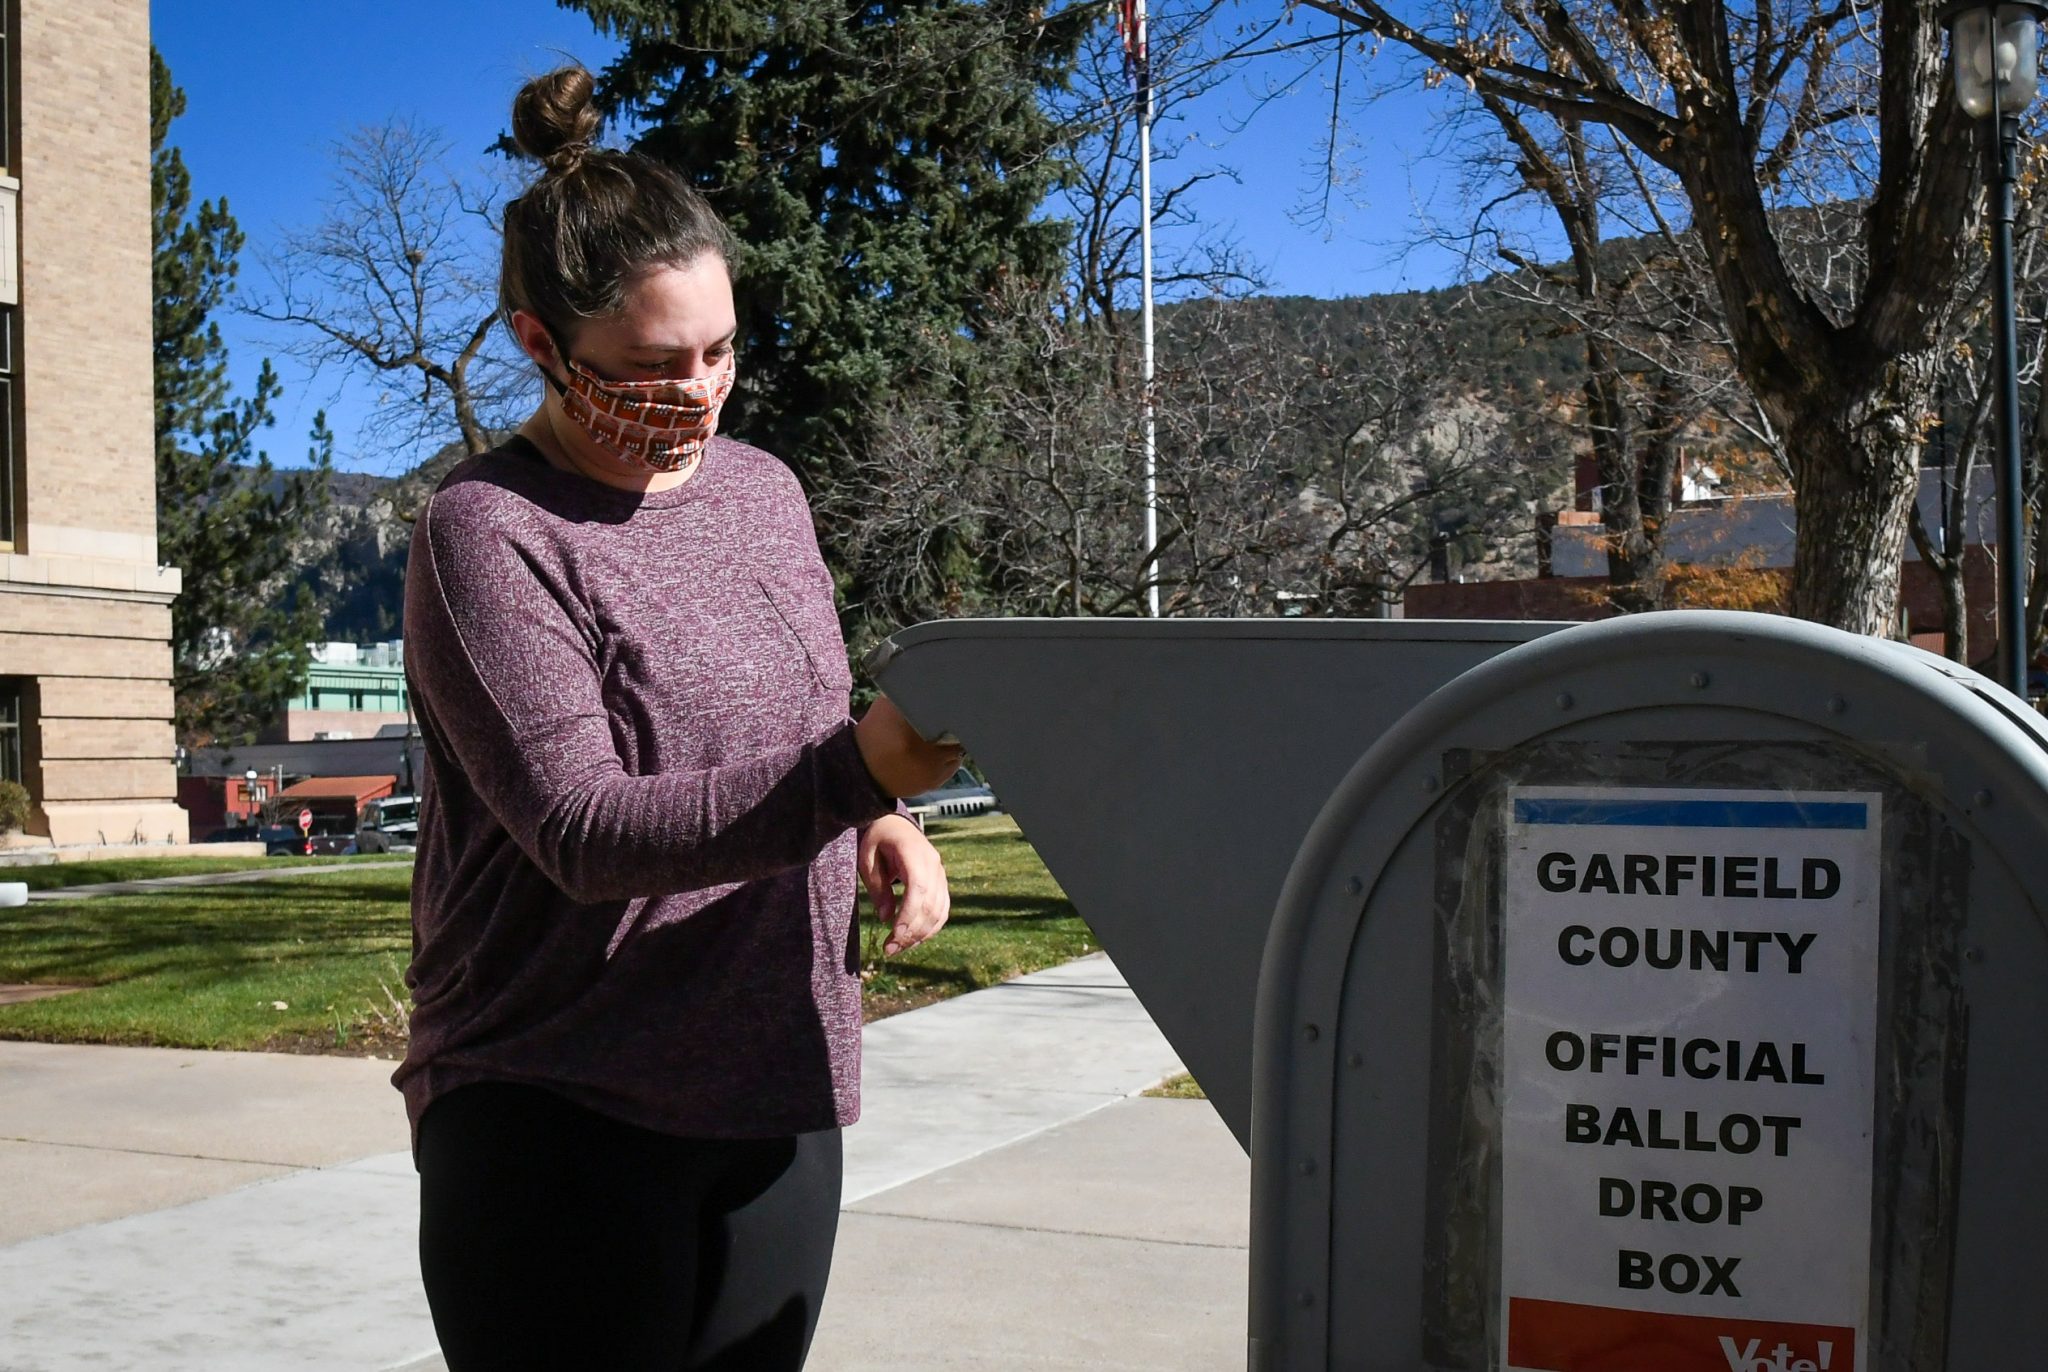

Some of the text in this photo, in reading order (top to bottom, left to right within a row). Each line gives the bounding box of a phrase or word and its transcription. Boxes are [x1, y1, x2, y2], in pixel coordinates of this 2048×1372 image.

[1537, 852, 1840, 899] GARFIELD
[1558, 925, 1817, 973] COUNTY
[1546, 1031, 1824, 1085] OFFICIAL
[1566, 1104, 1801, 1156] BALLOT
[1600, 1178, 1762, 1225] DROP
[1619, 1250, 1741, 1297] BOX
